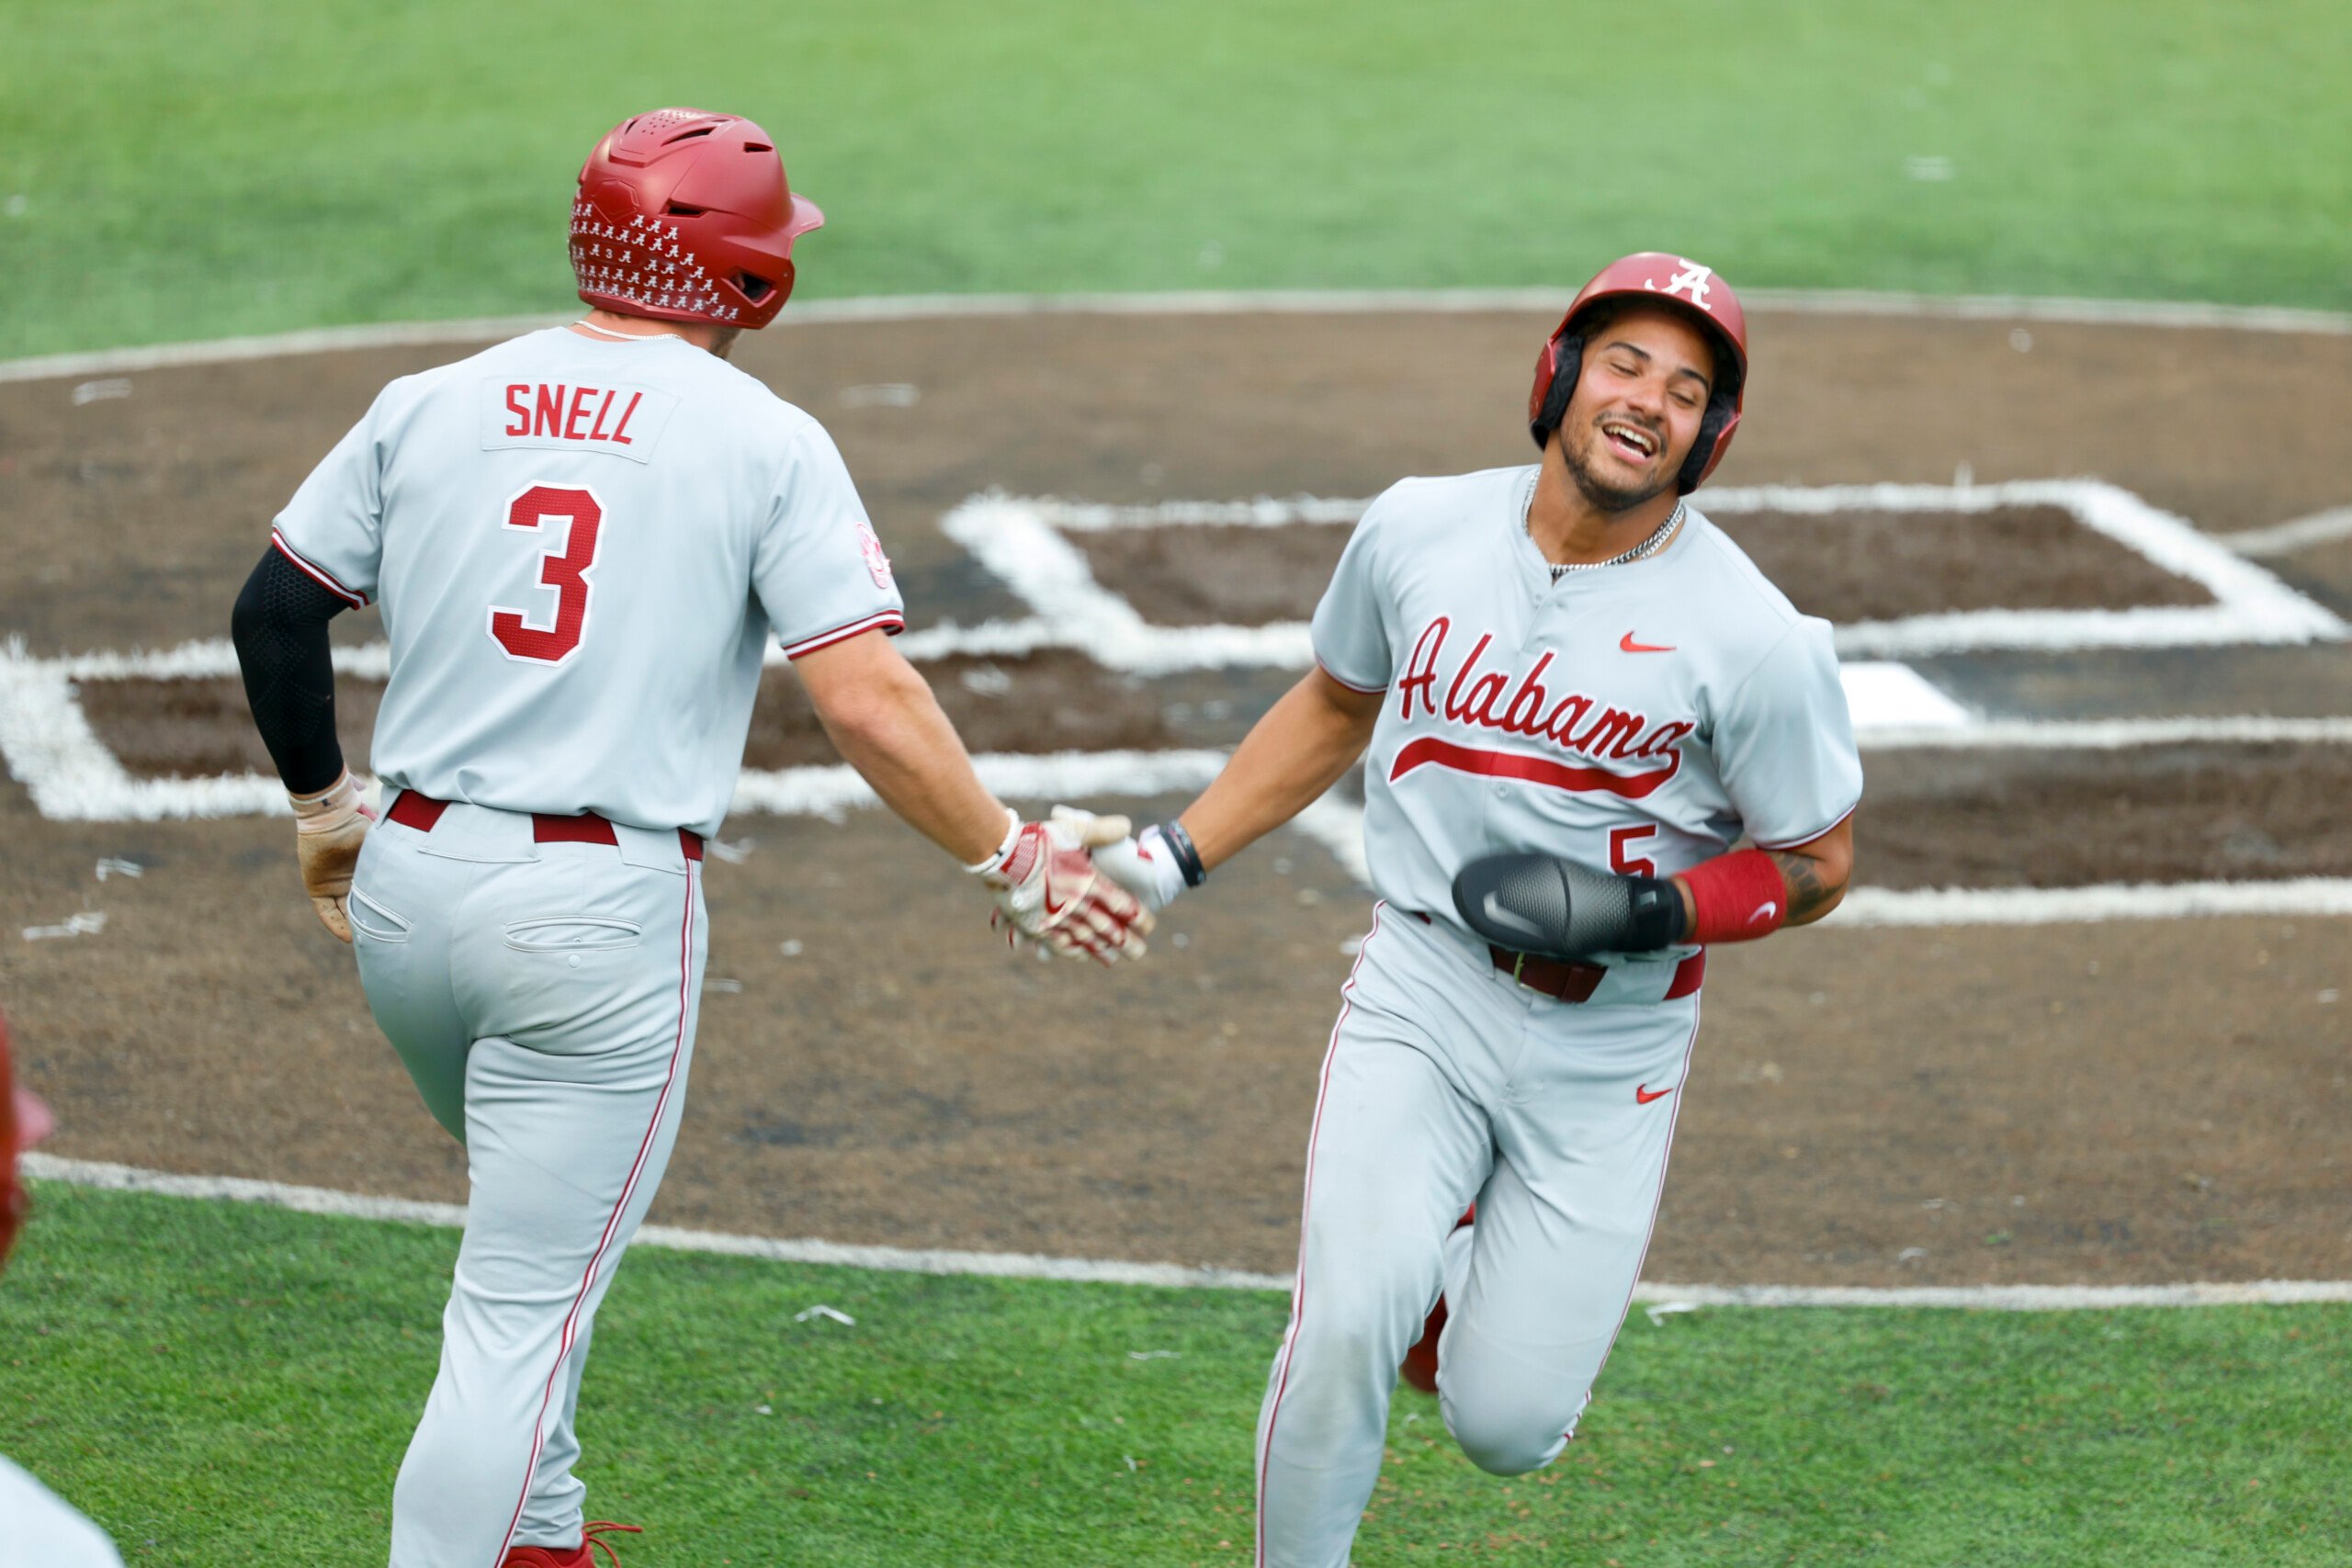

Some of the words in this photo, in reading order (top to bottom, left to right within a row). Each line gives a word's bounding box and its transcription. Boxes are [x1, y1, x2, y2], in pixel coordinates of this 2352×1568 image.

[1645, 258, 1713, 311] A
[505, 383, 643, 446] SNELL
[486, 479, 608, 668] 3
[1396, 614, 1696, 776] Alabama
